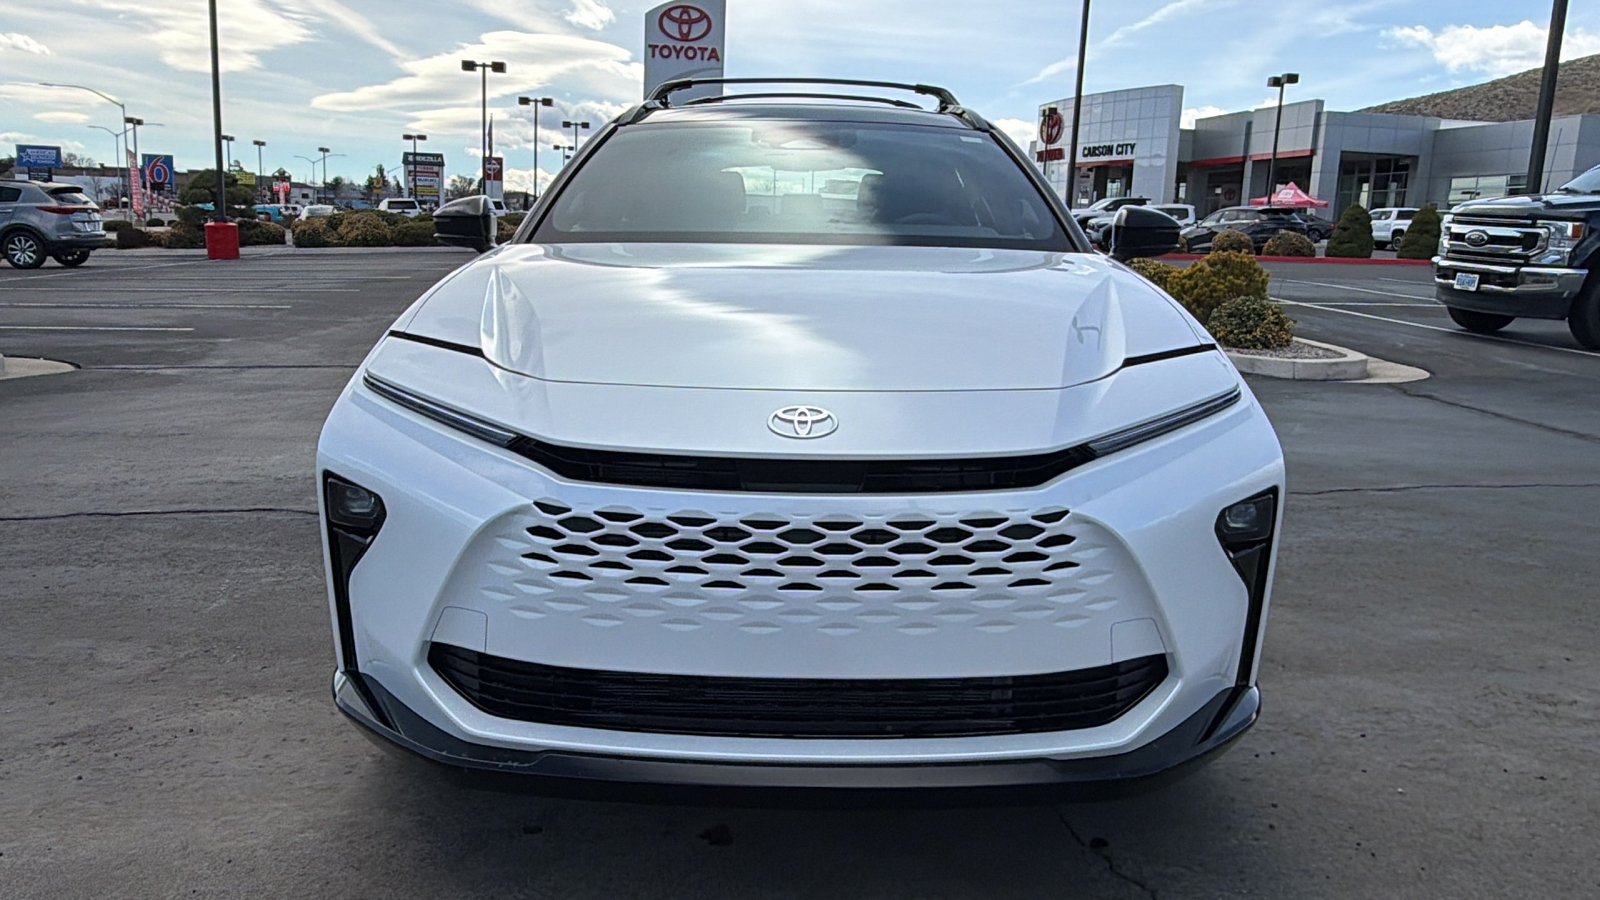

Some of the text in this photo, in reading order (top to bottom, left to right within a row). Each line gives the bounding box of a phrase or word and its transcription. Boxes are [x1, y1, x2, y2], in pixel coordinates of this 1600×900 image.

[648, 44, 720, 61] TOYOTA
[1082, 143, 1136, 157] CARSON CITY
[149, 156, 169, 183] 6
